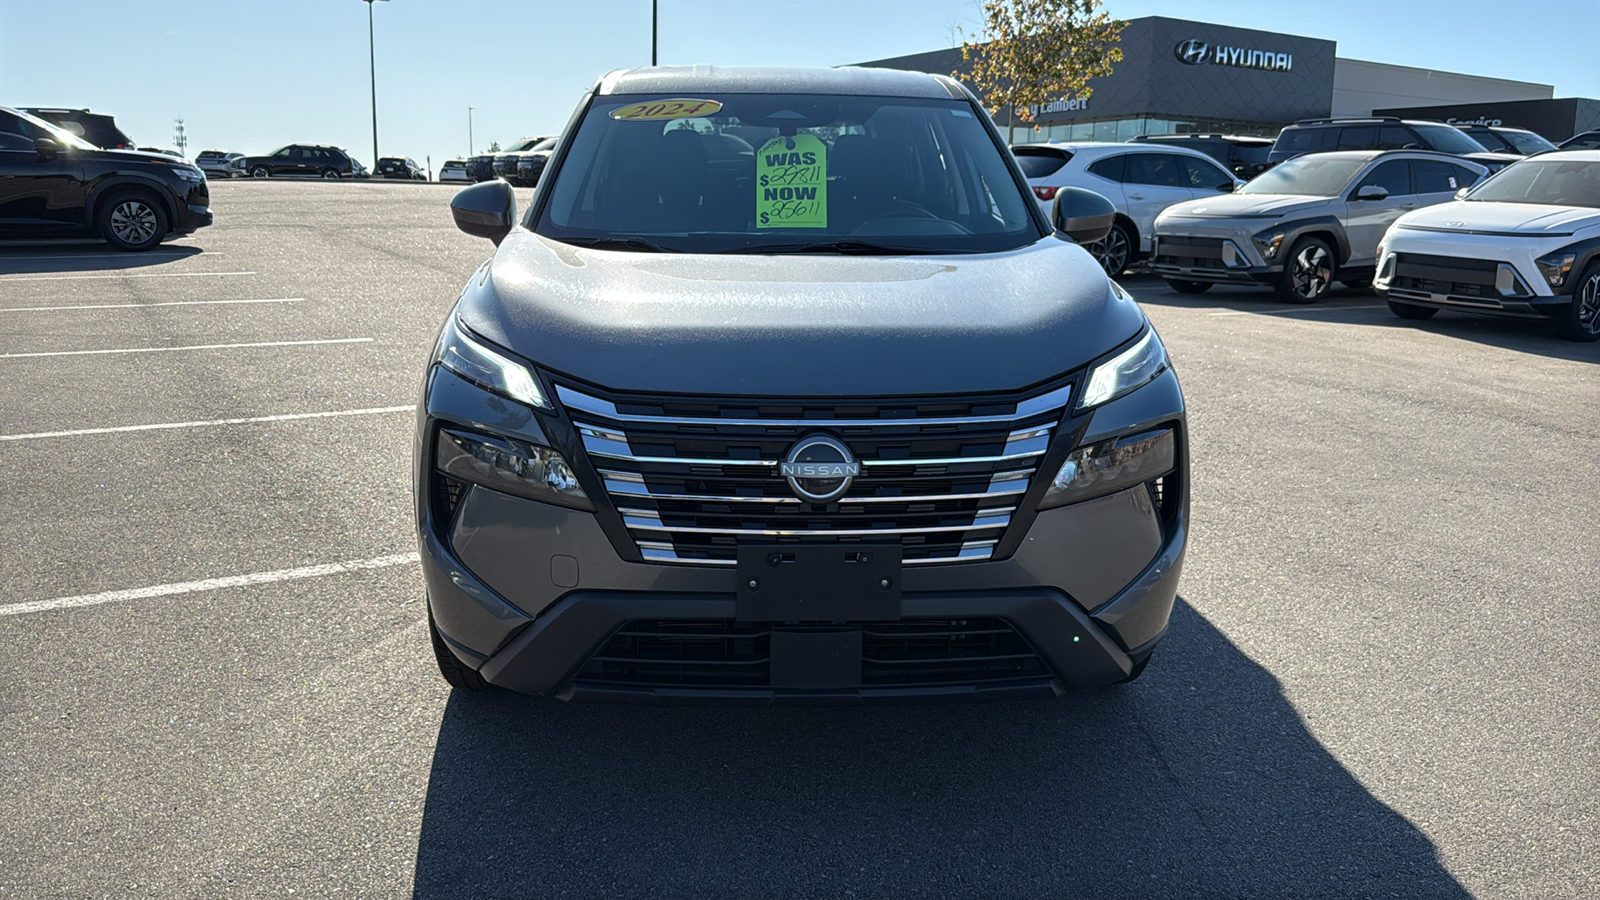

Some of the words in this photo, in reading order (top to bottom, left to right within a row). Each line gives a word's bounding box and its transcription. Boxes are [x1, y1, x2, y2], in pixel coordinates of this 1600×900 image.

[1215, 45, 1293, 71] HYUNDAI
[626, 101, 706, 118] 2024
[1040, 95, 1088, 114] Lambert
[765, 152, 817, 167] WAS
[764, 187, 817, 201] NOW
[782, 465, 857, 475] NISSAN
